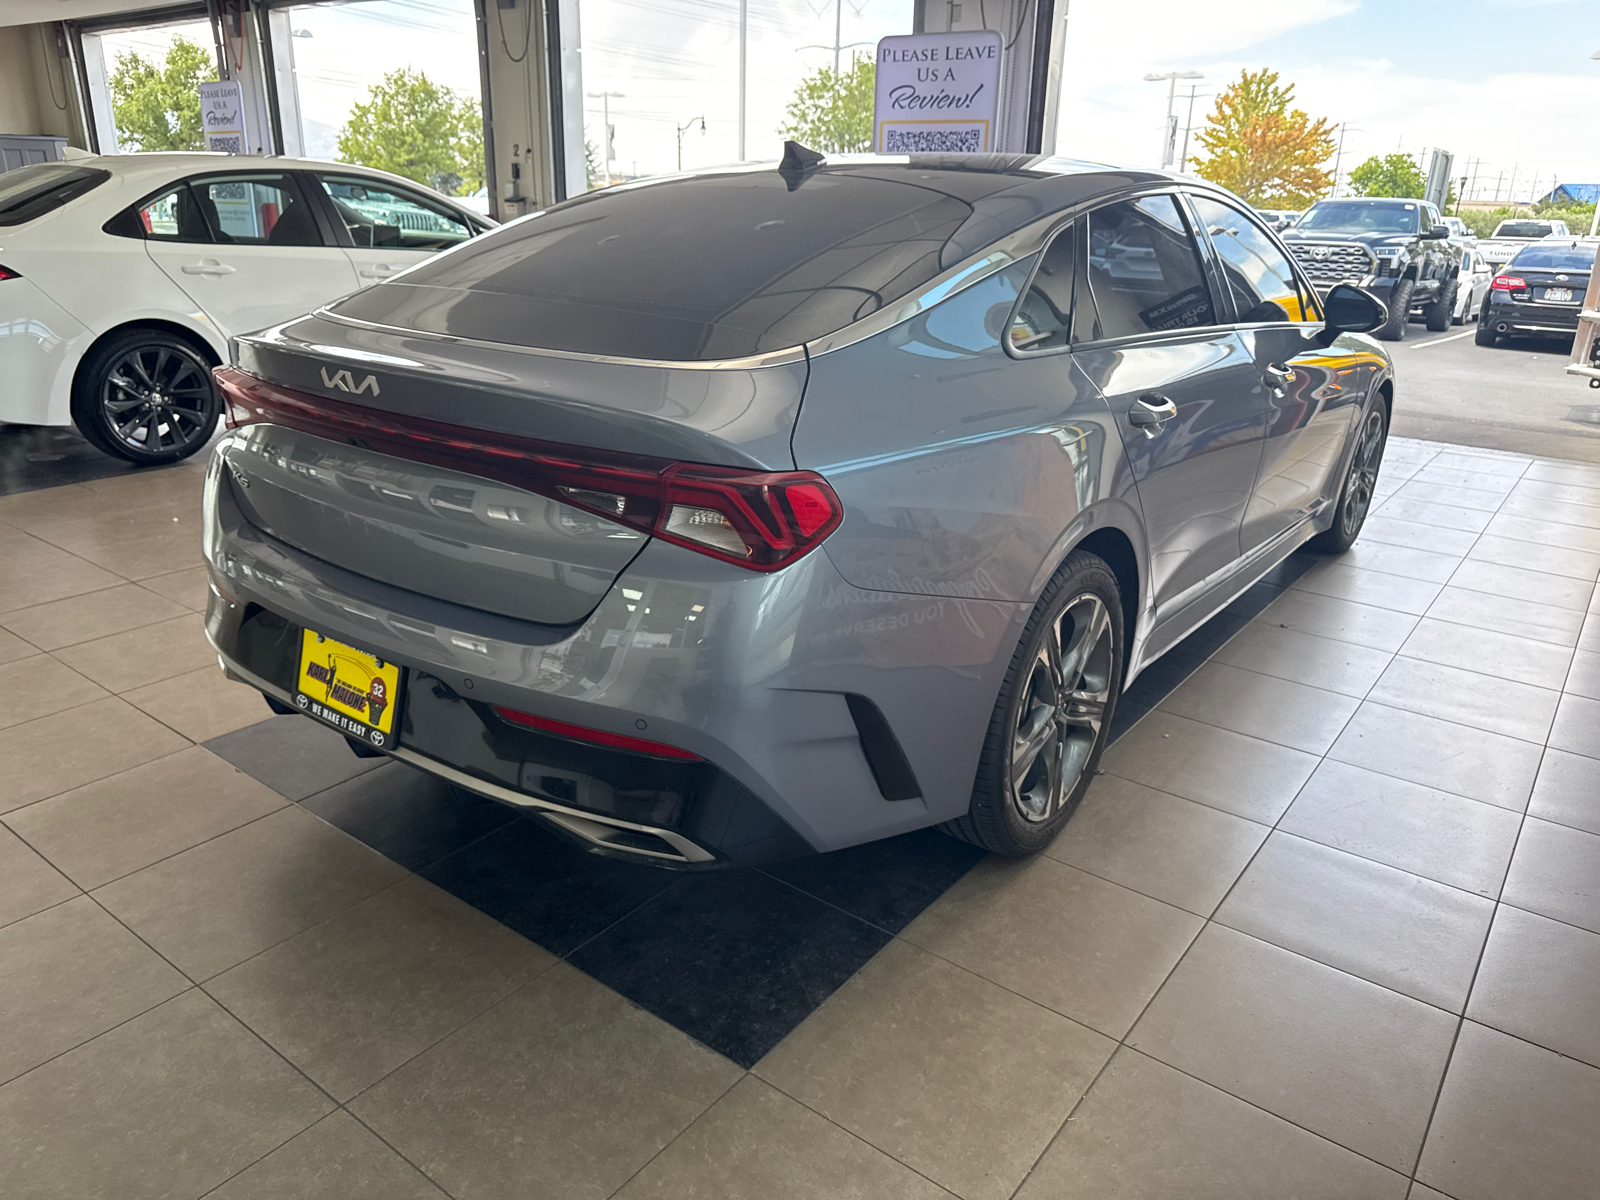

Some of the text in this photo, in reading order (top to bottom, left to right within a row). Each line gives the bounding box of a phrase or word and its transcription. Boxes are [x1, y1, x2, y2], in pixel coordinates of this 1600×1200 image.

[882, 45, 996, 62] PLEASE LEAVE
[943, 67, 956, 81] A
[201, 88, 237, 99] PLEASE LEAVE
[888, 83, 984, 110] Review!
[223, 101, 227, 109] A
[206, 110, 237, 125] Review!
[513, 144, 520, 157] 2
[320, 366, 380, 397] KIA
[306, 661, 331, 684] KARL
[330, 683, 368, 713] MALONE
[373, 683, 384, 698] 32
[311, 703, 366, 737] WE MAKE IT EASY
